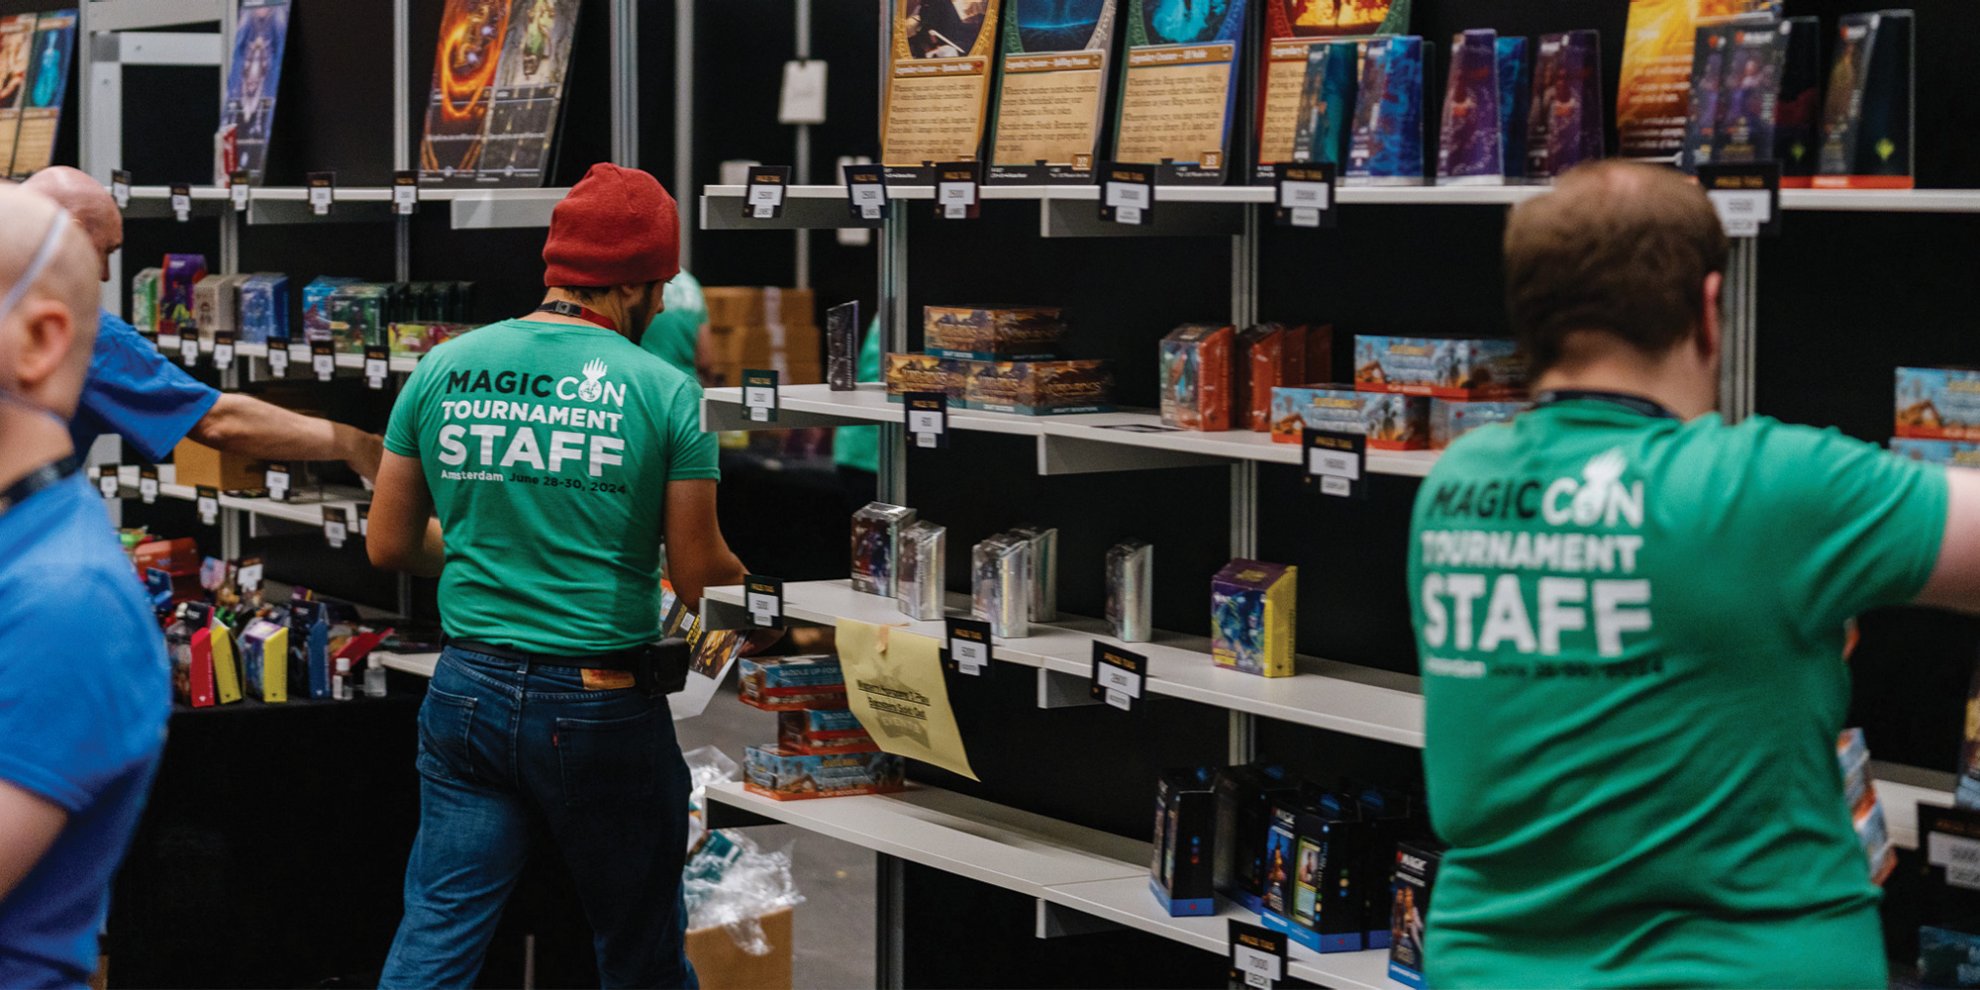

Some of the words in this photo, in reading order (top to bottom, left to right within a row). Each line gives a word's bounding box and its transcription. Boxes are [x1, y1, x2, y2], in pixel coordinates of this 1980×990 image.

[441, 400, 623, 433] TOURNAMENT
[437, 424, 625, 477] STAFF
[441, 469, 504, 482] Amsterdam
[509, 473, 539, 486] June
[590, 481, 626, 494] 2024
[1421, 530, 1644, 574] TOURNAMENT
[1422, 572, 1652, 658] STAFF
